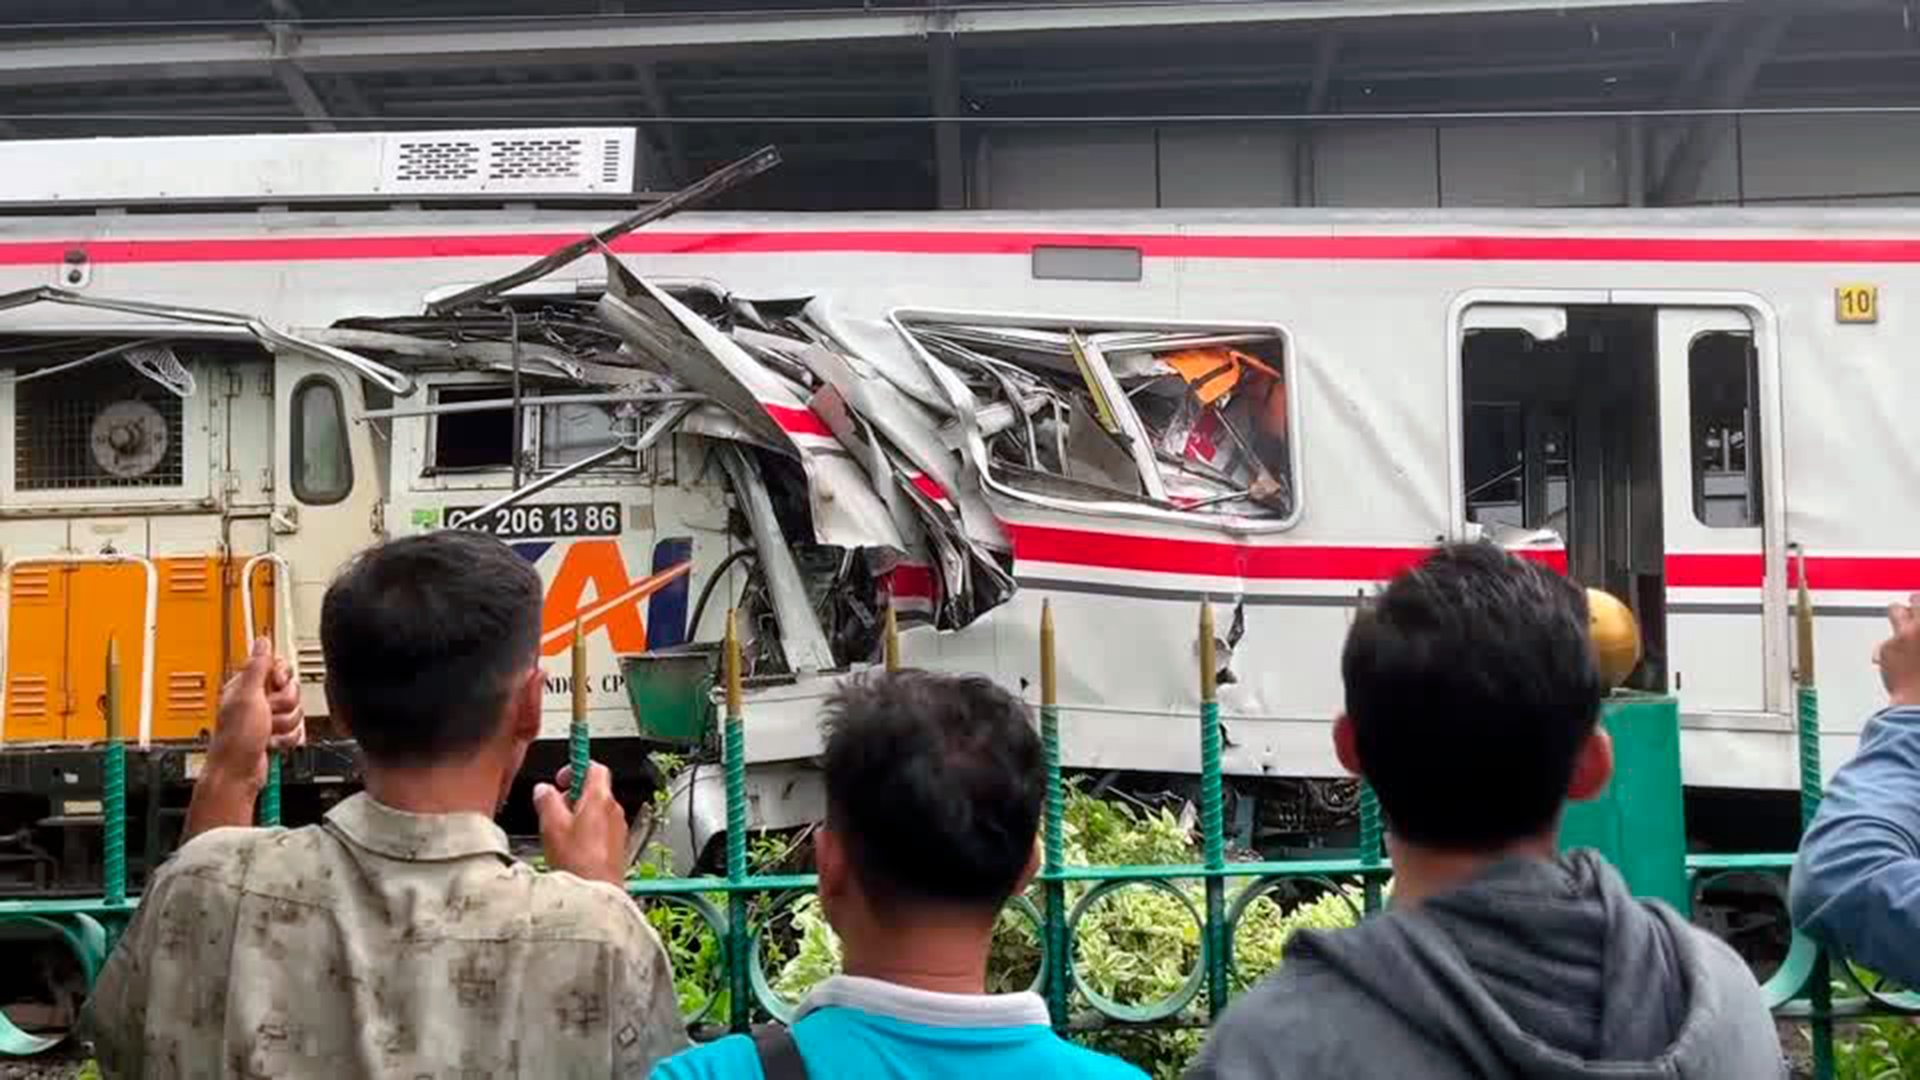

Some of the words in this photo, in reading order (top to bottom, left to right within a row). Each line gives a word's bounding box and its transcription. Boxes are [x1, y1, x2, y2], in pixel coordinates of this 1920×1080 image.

[1842, 290, 1870, 313] 10
[495, 507, 544, 536] 206
[550, 506, 577, 533] 13
[584, 505, 617, 532] 86
[512, 537, 693, 656] AI
